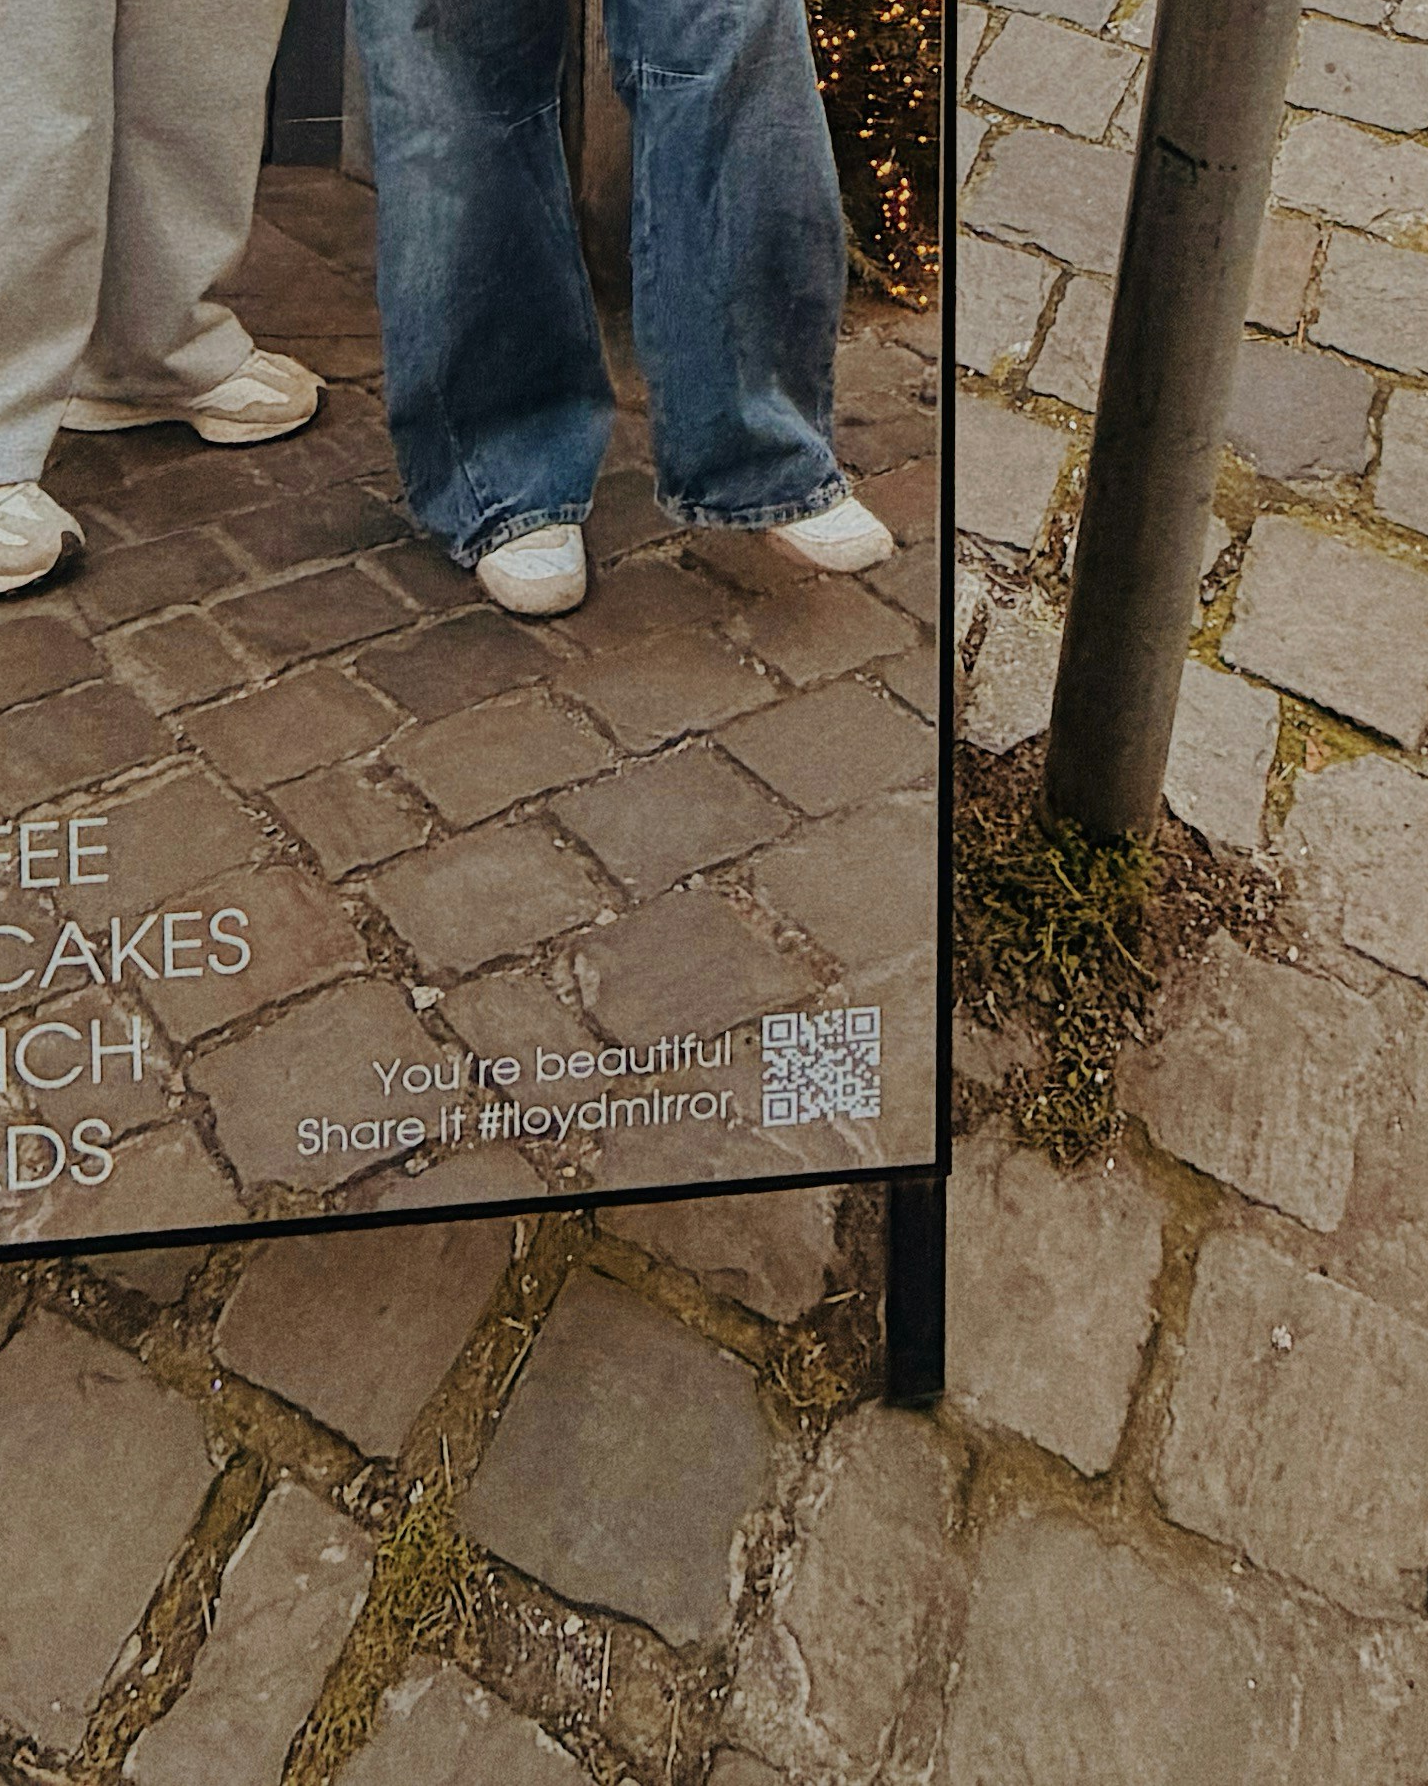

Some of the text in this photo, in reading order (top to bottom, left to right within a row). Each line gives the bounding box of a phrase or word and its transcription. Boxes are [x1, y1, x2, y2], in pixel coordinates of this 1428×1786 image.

[372, 1031, 733, 1097] You're beautiful
[297, 1118, 426, 1157] Share
[478, 1087, 736, 1143] #lloydmirror
